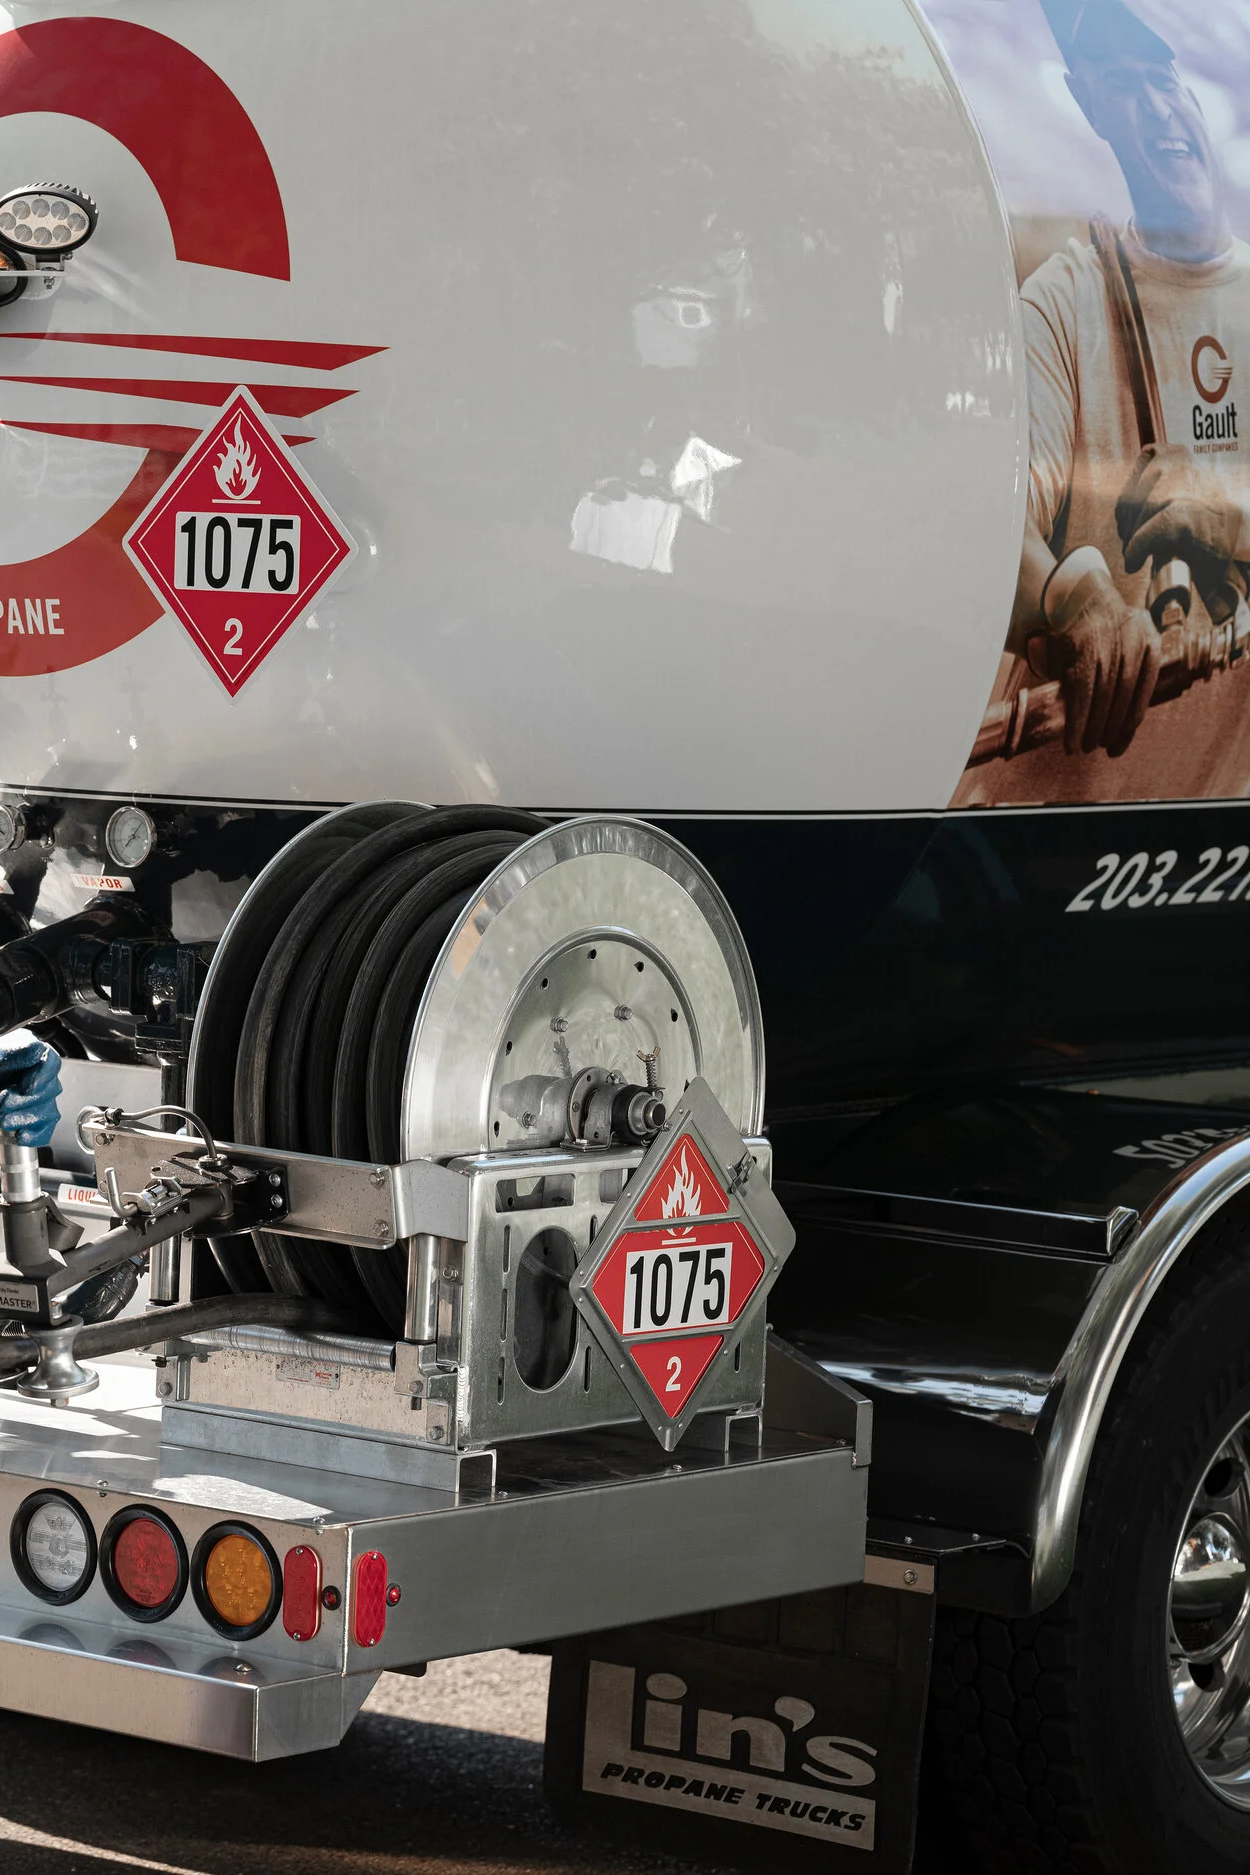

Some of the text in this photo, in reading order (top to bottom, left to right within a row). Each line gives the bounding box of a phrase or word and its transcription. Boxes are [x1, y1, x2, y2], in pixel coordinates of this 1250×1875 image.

[1192, 402, 1238, 440] Gault
[180, 516, 296, 592] 1075
[223, 617, 244, 656] 2
[80, 875, 123, 889] VAPOR
[629, 1247, 727, 1330] 1075
[665, 1355, 682, 1393] 2
[582, 1659, 878, 1790] Lin's
[599, 1762, 867, 1832] PROPANE TRUCKS
